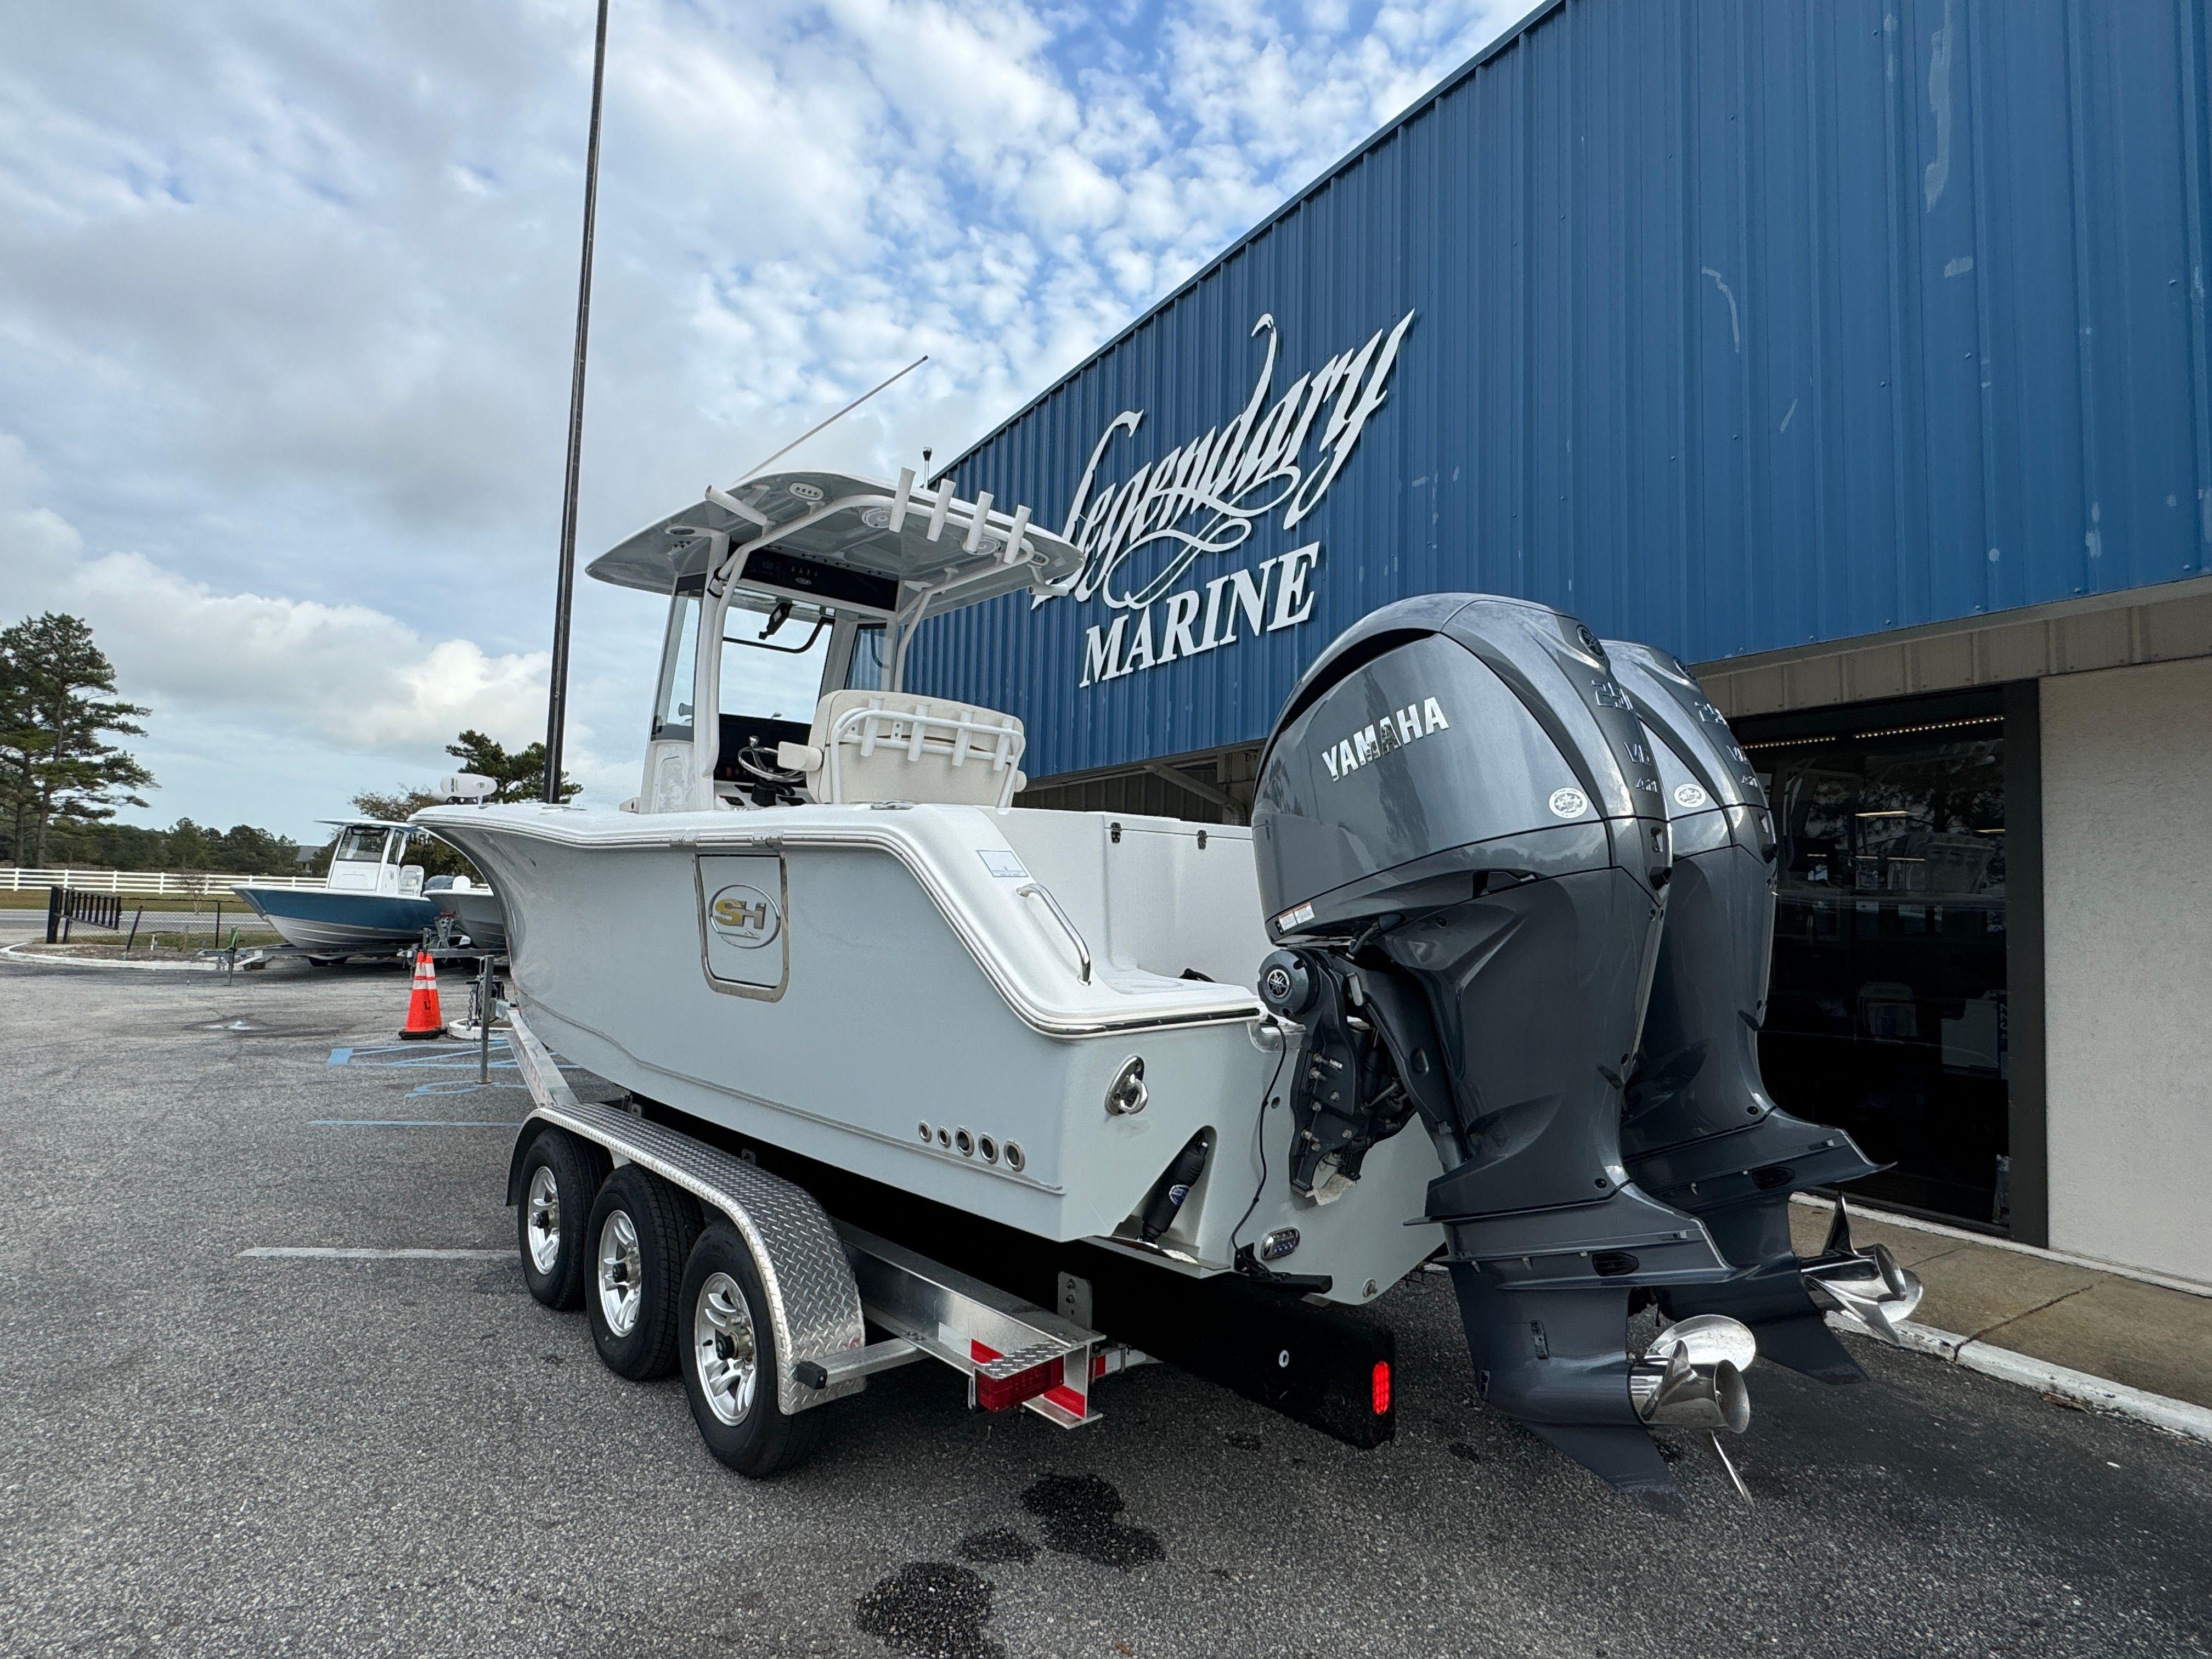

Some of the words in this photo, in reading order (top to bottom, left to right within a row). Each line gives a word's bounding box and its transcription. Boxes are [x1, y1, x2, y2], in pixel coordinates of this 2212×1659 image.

[1031, 308, 1415, 610] Legendary
[1079, 541, 1319, 688] MARINE
[1322, 697, 1449, 782] YAMAHA
[715, 898, 767, 930] SH
